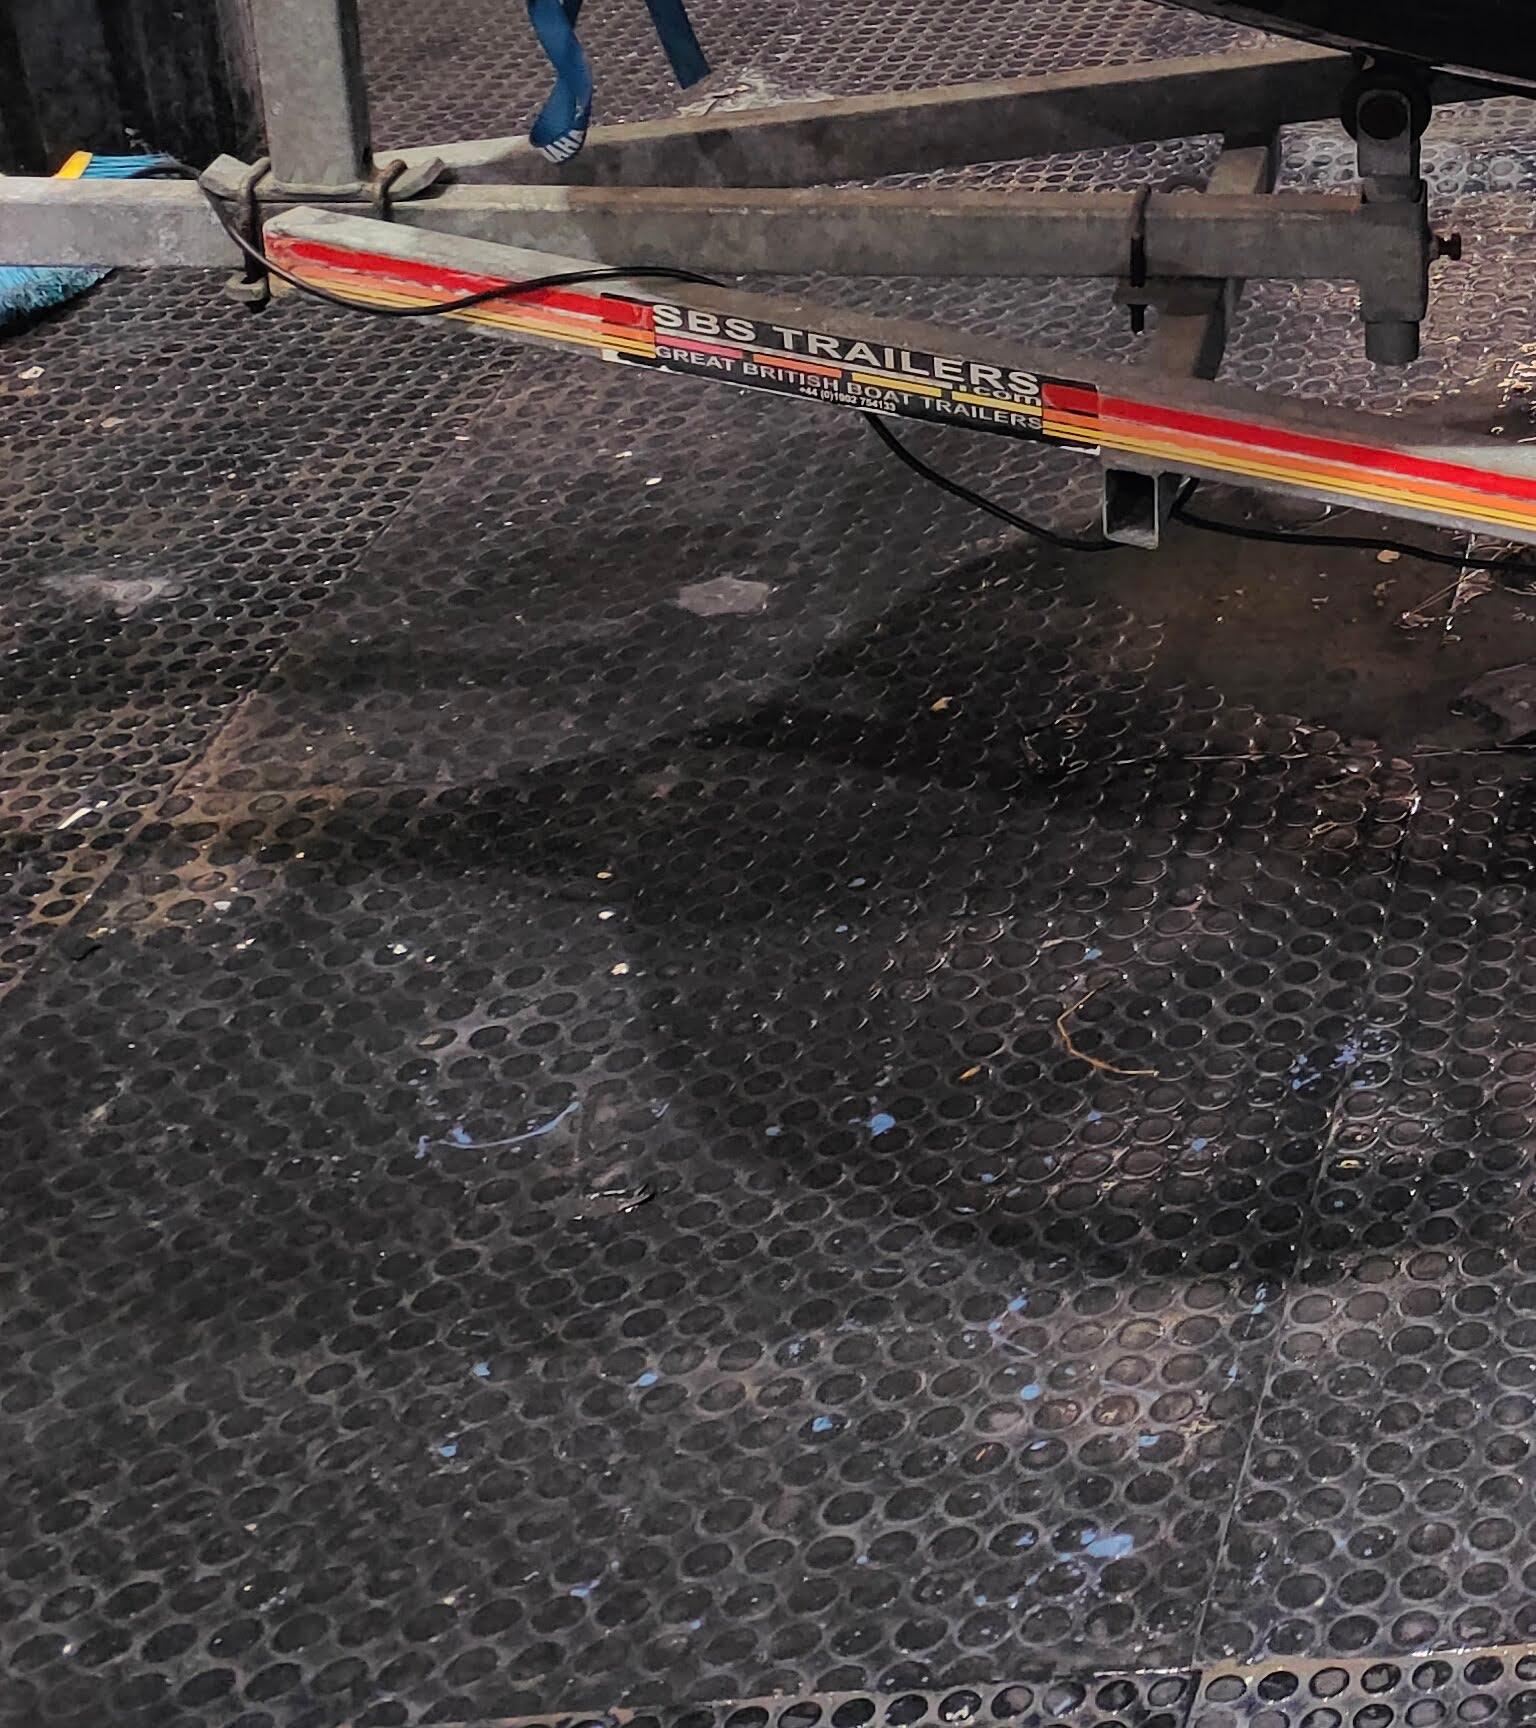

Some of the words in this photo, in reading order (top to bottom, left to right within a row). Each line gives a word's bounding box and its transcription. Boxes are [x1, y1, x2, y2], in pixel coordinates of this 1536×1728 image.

[652, 303, 755, 342] SBS
[773, 325, 1041, 396] TRAILERS
[655, 345, 736, 372] GREAT
[742, 362, 839, 392] BRITISH
[846, 381, 916, 406] BOAT
[919, 396, 1042, 430] TRAILERS
